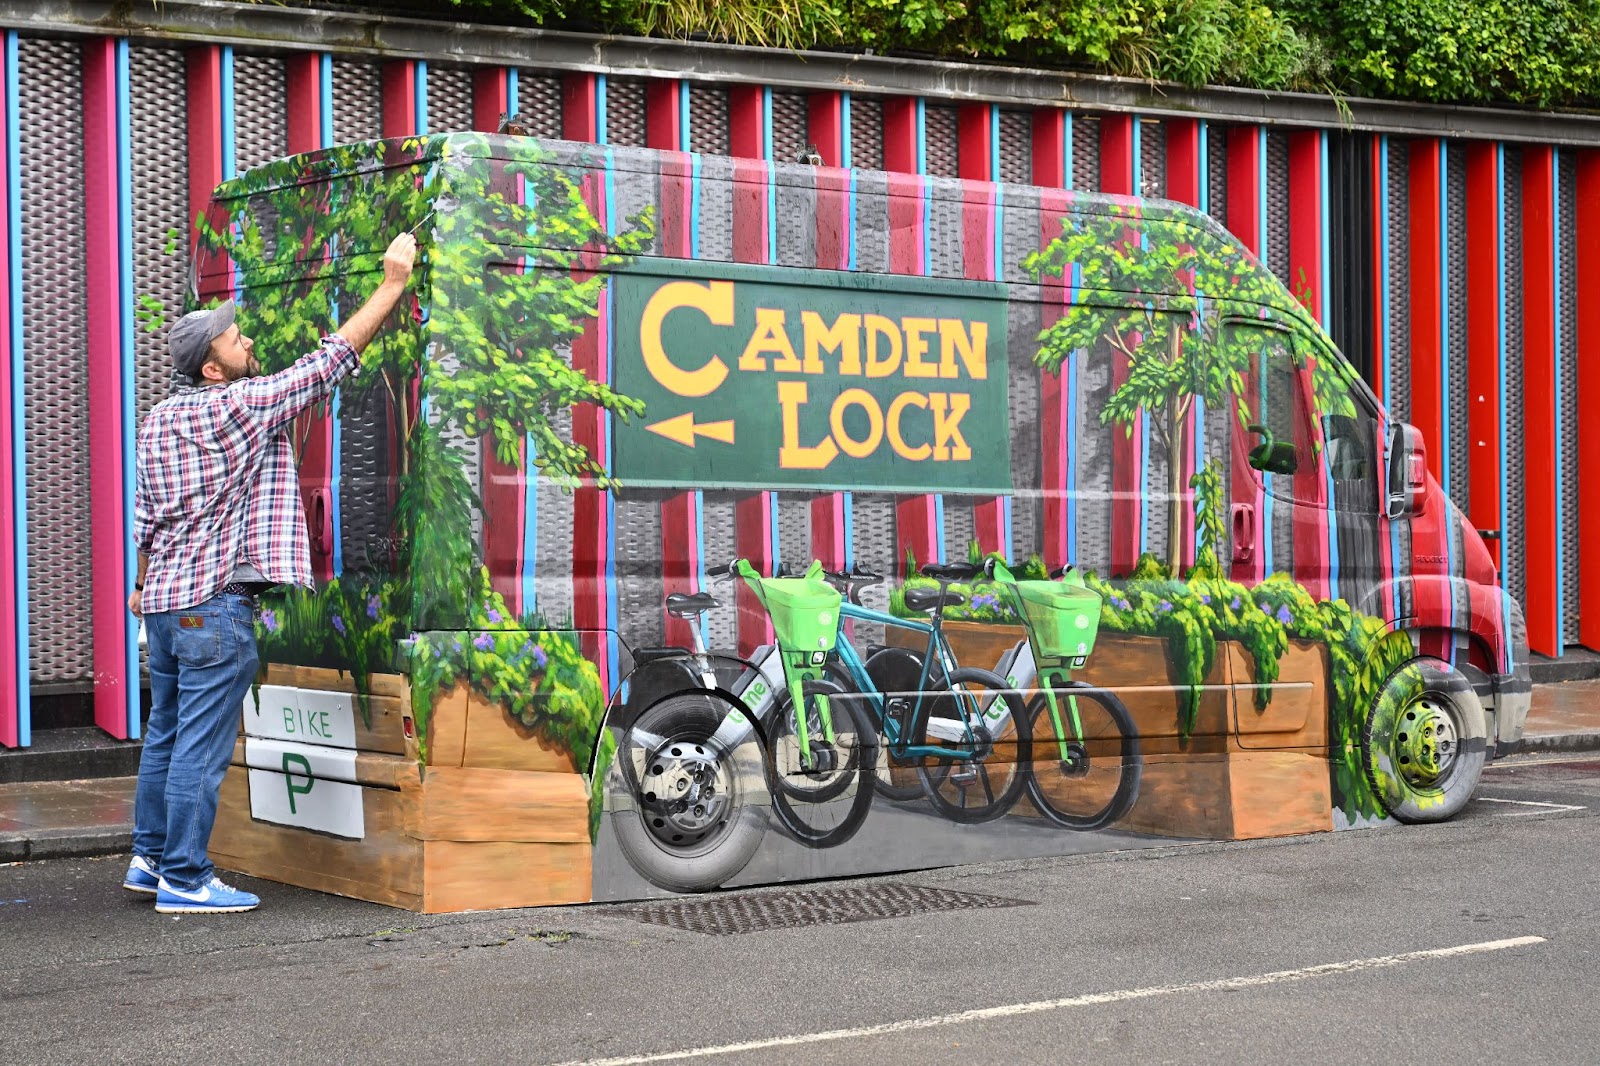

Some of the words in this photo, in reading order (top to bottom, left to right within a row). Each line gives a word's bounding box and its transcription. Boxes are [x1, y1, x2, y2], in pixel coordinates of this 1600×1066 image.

[640, 280, 988, 397] CAMDEN
[777, 381, 972, 469] LOCK
[1414, 554, 1448, 564] PEUGEOT
[282, 707, 333, 739] BIKE
[282, 752, 315, 814] P
